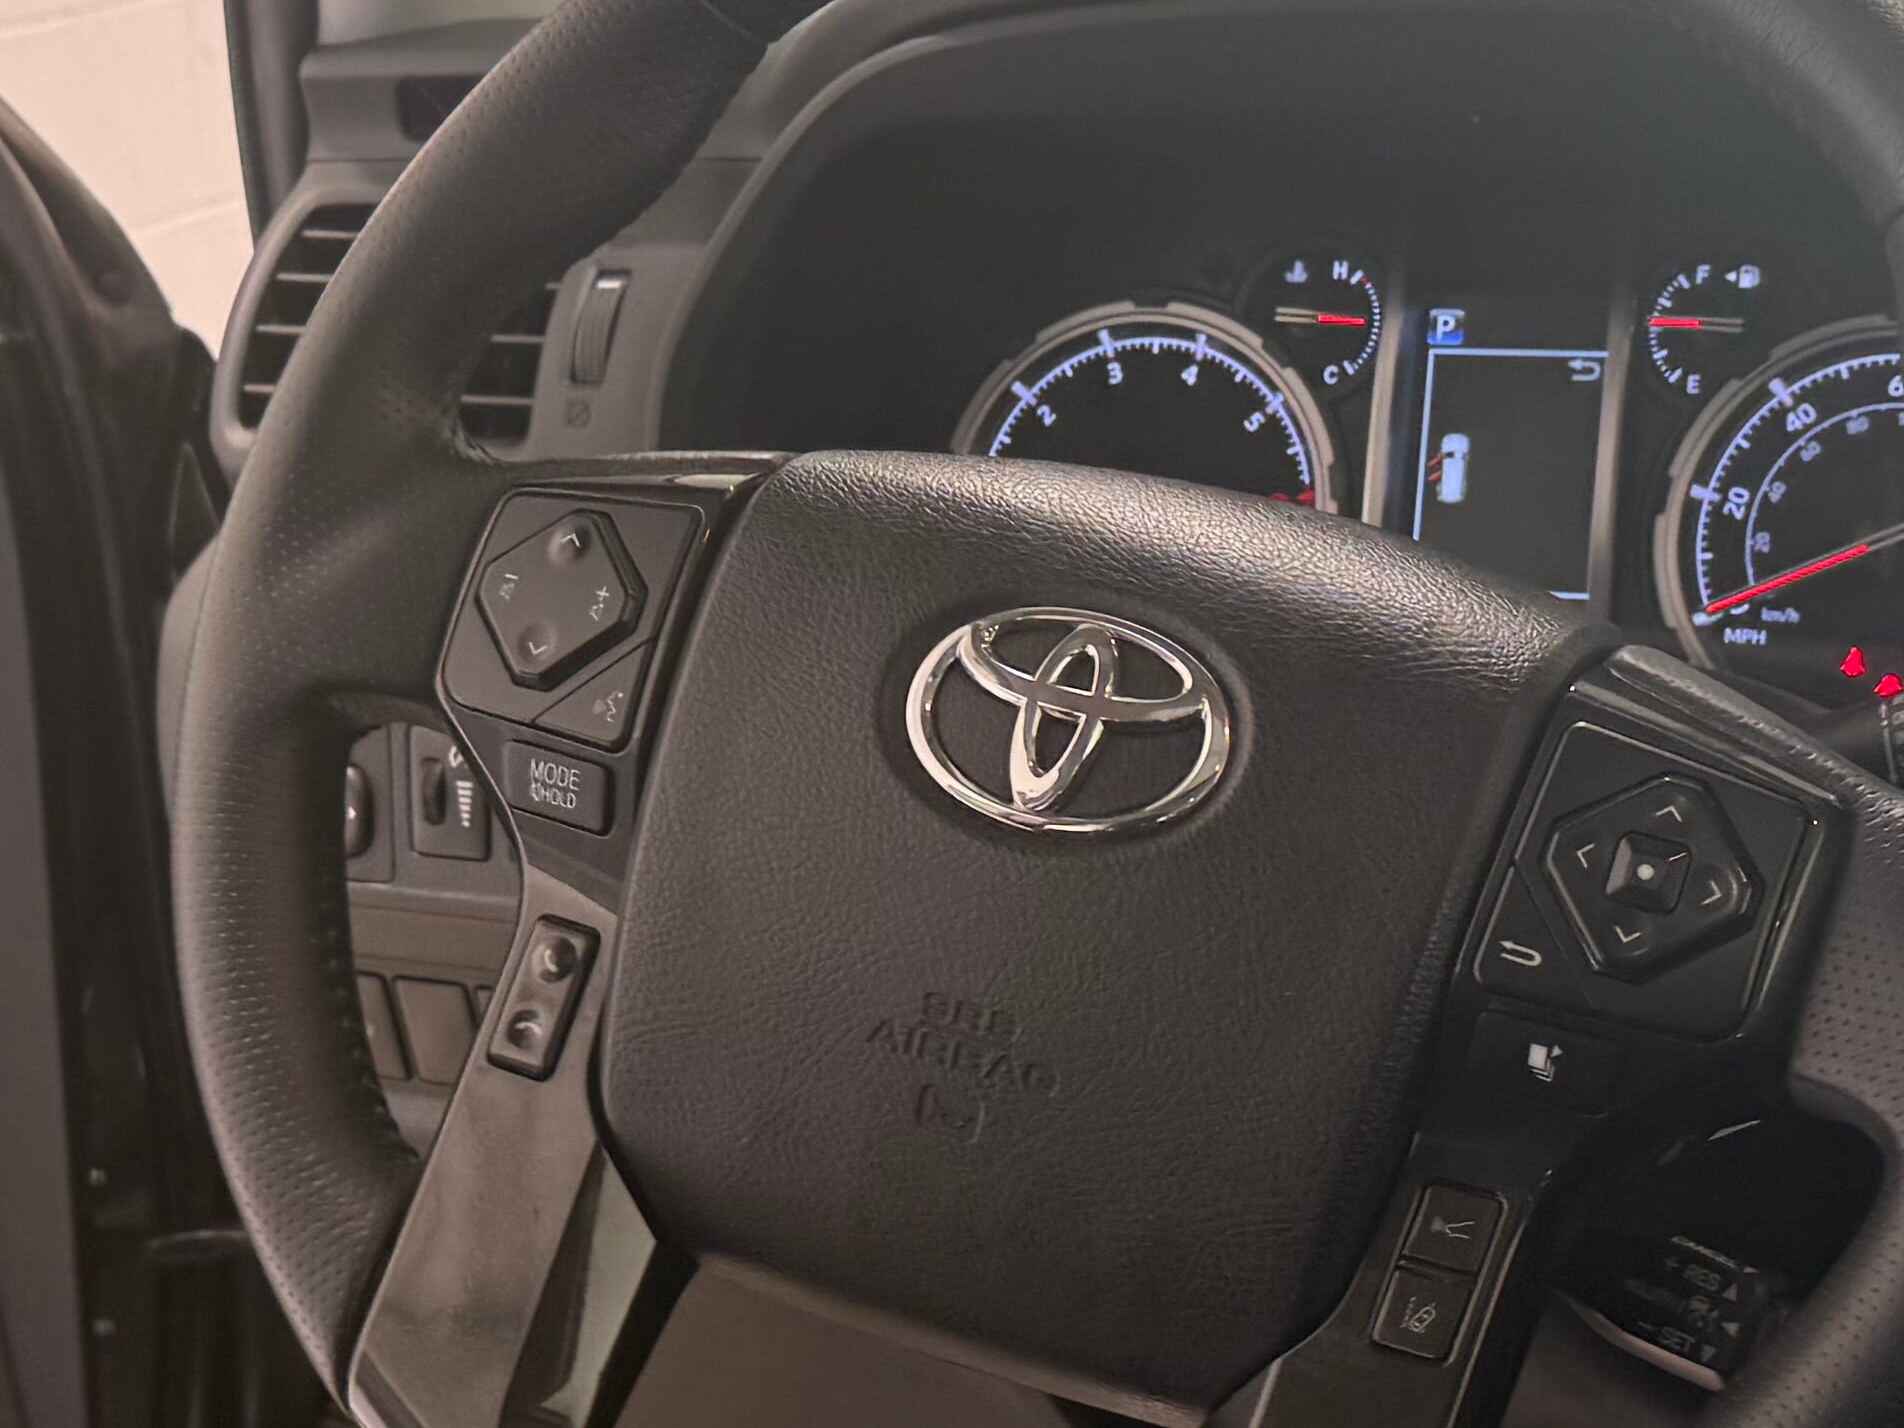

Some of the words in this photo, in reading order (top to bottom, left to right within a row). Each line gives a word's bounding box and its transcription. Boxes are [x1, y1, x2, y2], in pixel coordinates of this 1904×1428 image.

[1331, 259, 1350, 281] H
[1695, 264, 1712, 285] F
[1435, 314, 1457, 343] P
[1105, 361, 1124, 386] 3
[1181, 364, 1200, 387] 4
[1322, 366, 1340, 385] C
[1685, 373, 1702, 395] E
[1035, 404, 1058, 428] 2
[1242, 411, 1266, 434] 5
[1785, 402, 1818, 433] 40
[1721, 485, 1752, 521] 20
[1723, 626, 1768, 646] MPH
[528, 758, 581, 792] MODE
